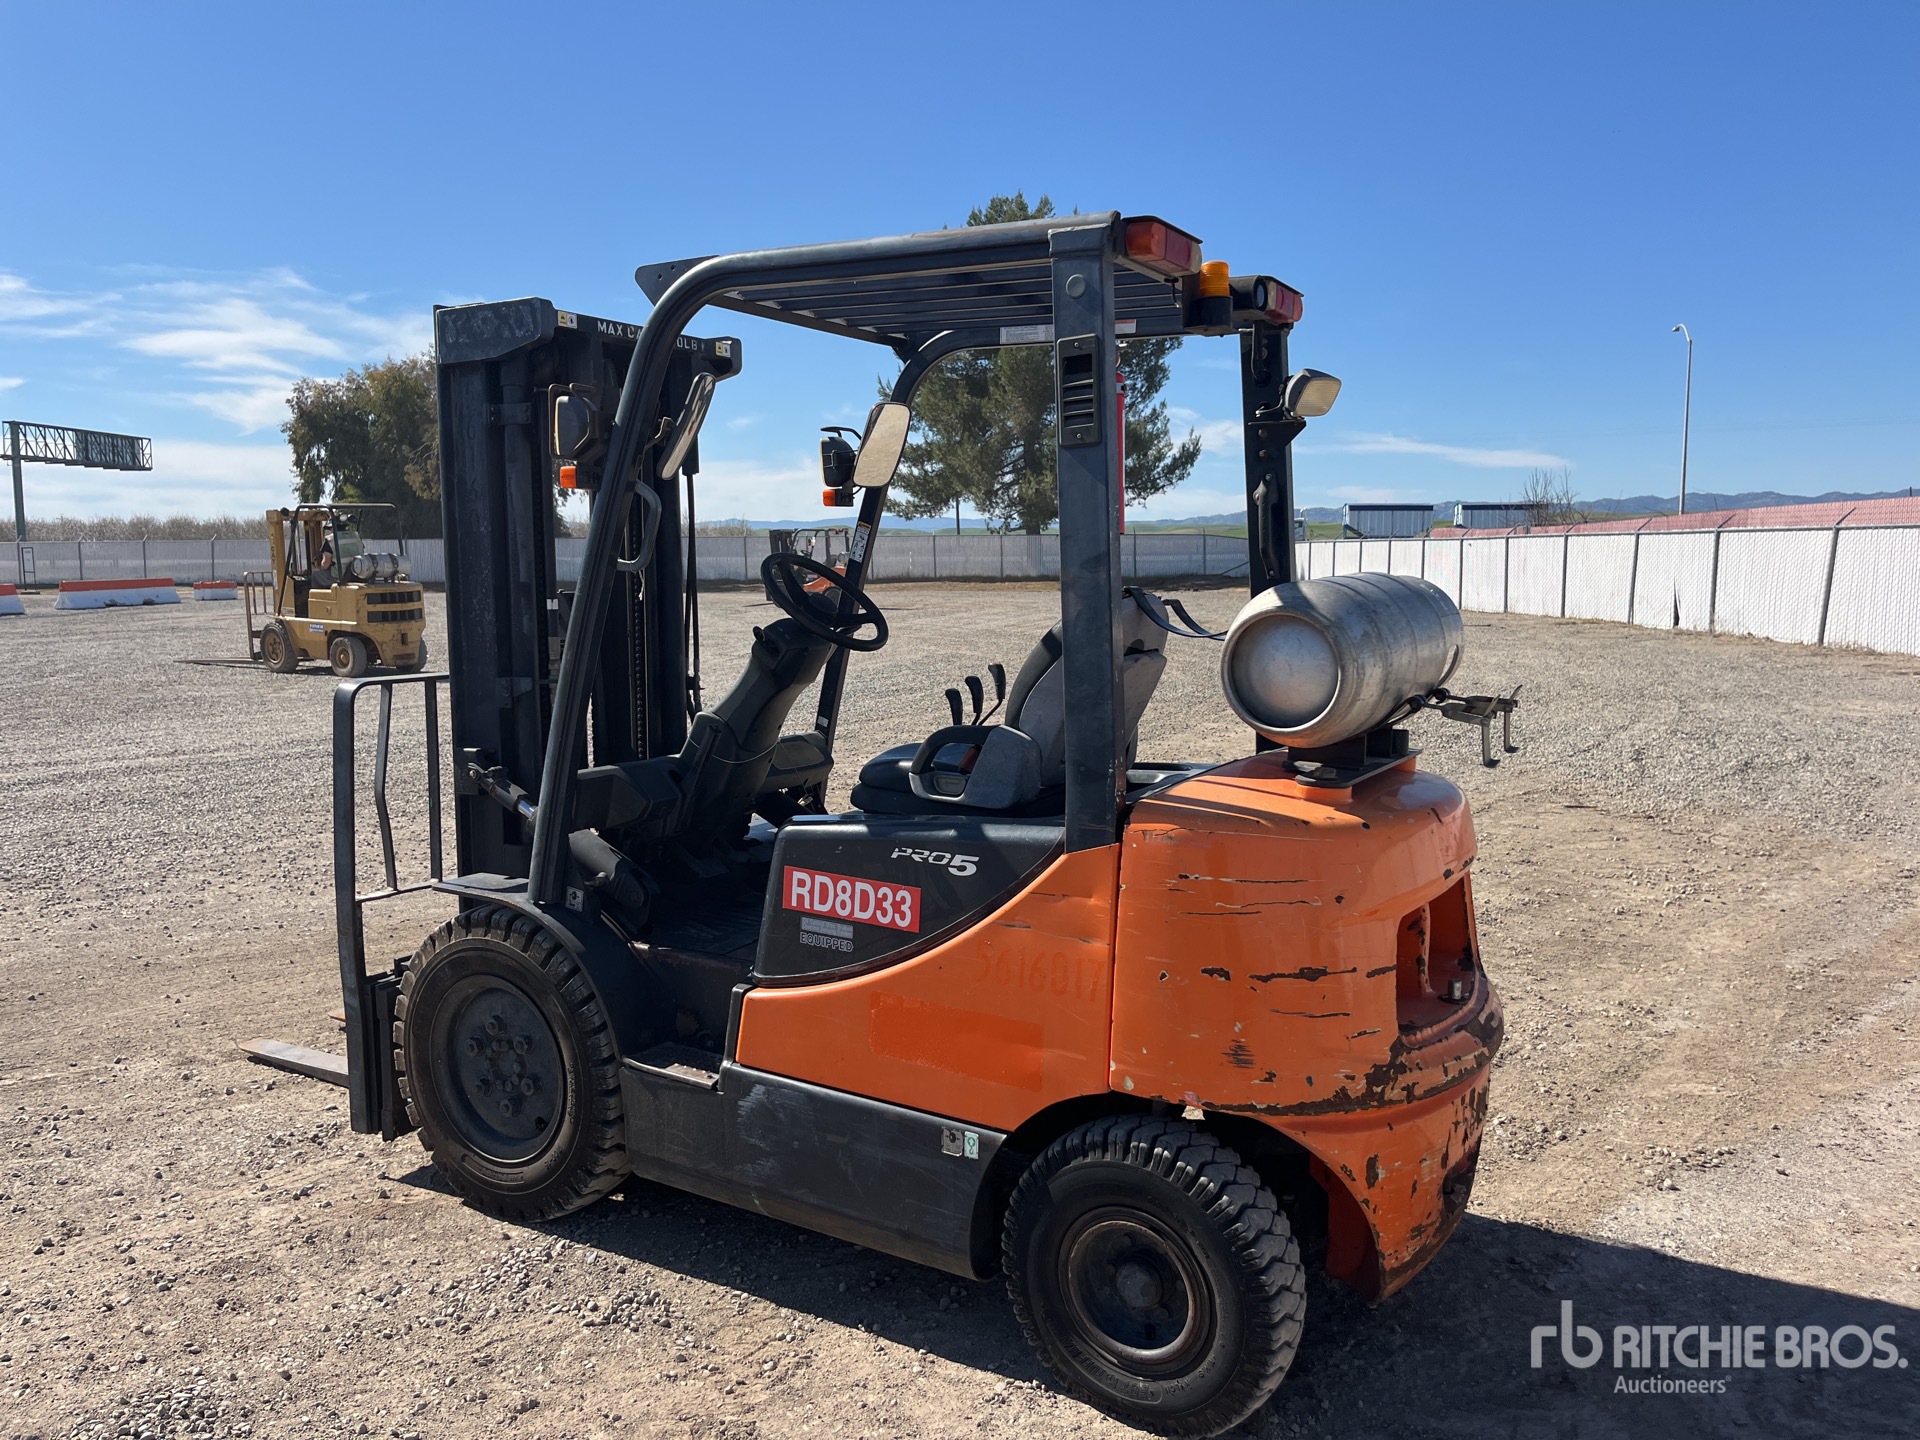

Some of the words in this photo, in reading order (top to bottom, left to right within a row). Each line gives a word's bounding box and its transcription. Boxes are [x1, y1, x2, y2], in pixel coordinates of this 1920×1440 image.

[597, 320, 624, 337] MAX
[791, 870, 912, 928] RD8D33
[799, 931, 854, 953] EQUIPPED
